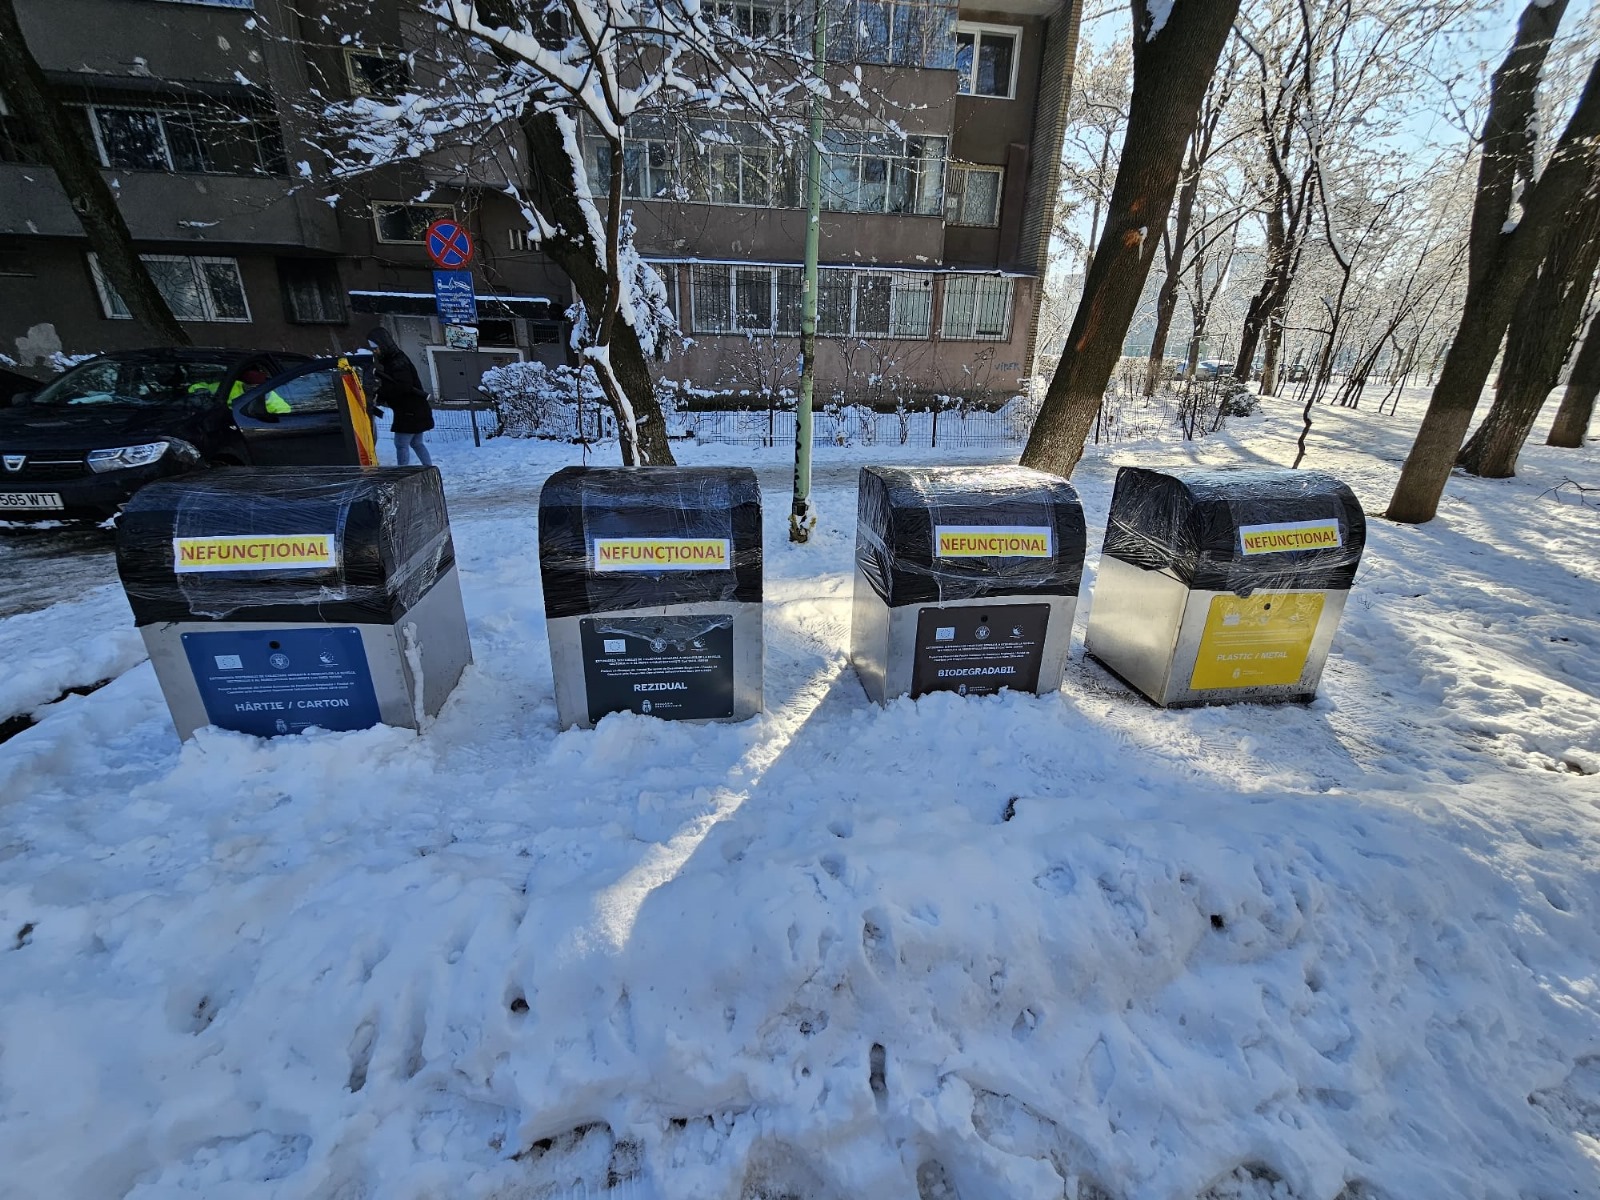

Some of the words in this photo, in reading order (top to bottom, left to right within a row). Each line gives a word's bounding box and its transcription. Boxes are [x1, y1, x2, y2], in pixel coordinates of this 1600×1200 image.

[0, 494, 26, 506] 565
[26, 494, 57, 506] WTT
[1216, 653, 1253, 661] PLASTIC
[1260, 651, 1288, 659] METAL
[938, 666, 1017, 677] BIODEGRADABIL
[633, 682, 688, 692] REZIDUAL
[297, 698, 350, 709] CARTON
